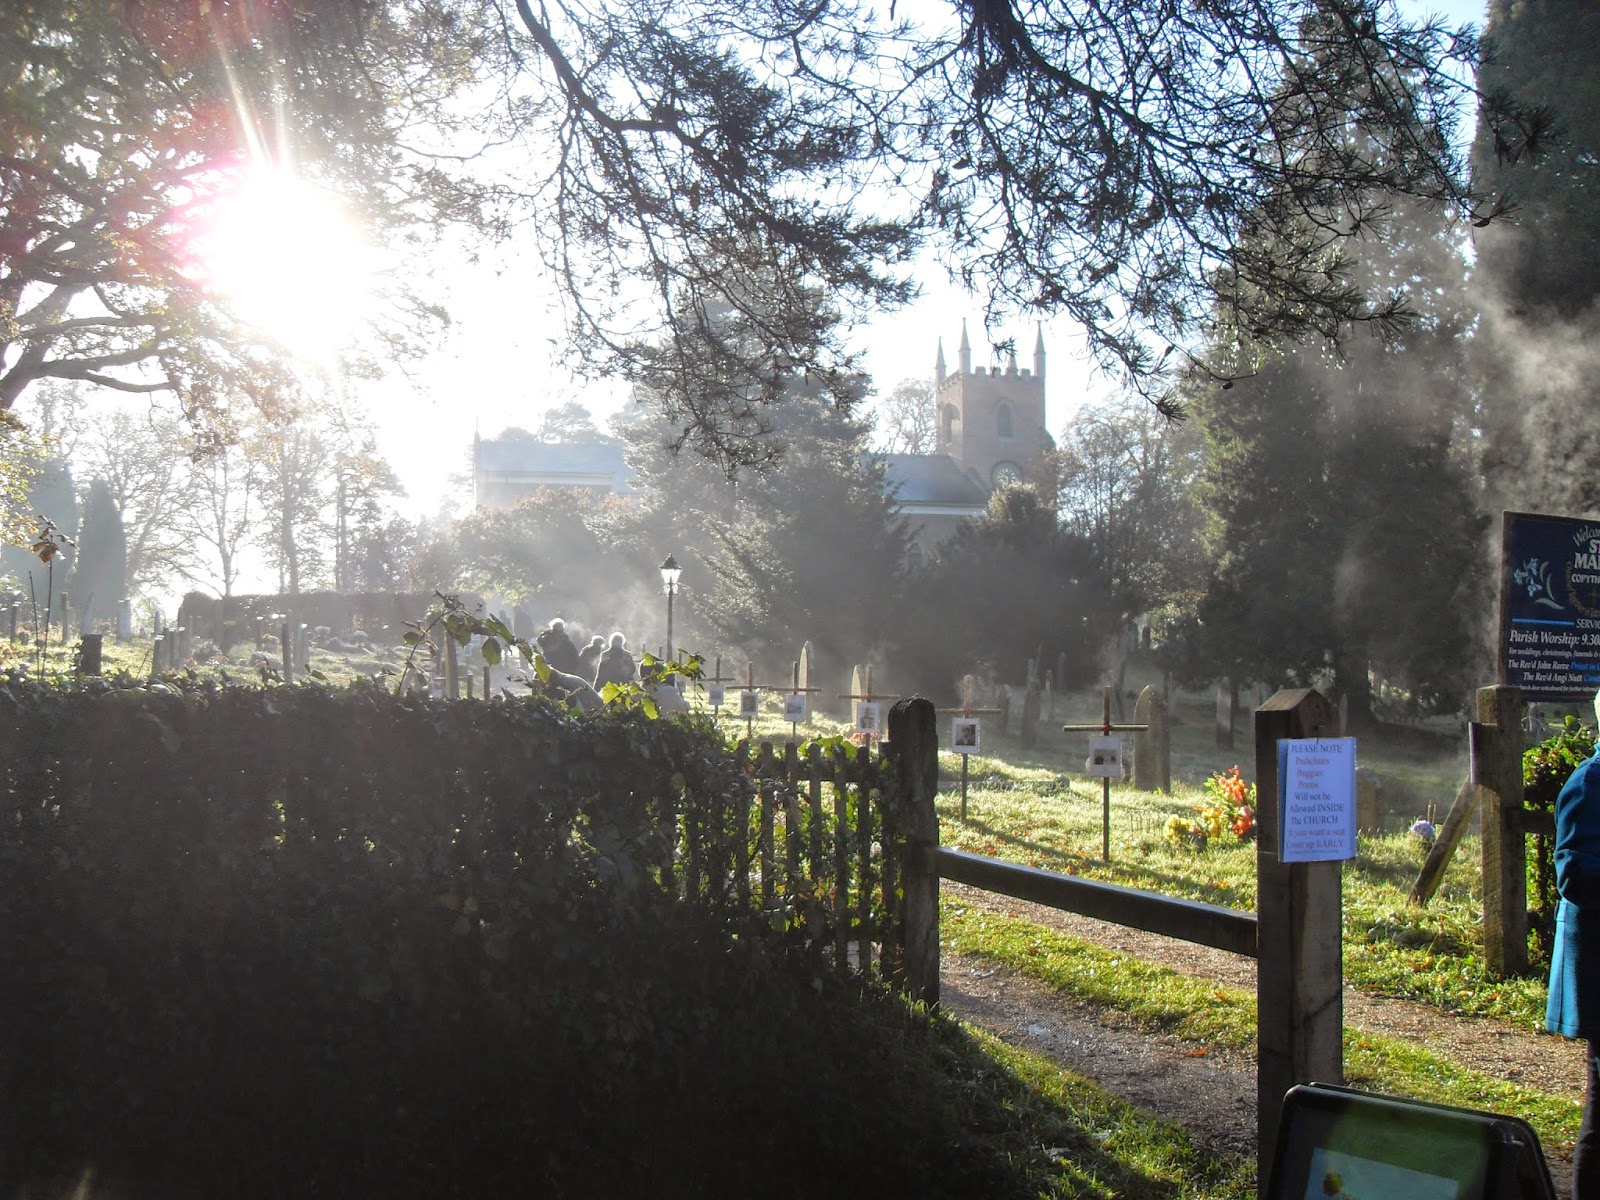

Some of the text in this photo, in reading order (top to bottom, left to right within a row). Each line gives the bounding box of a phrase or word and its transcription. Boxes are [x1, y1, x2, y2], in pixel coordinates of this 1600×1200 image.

[1509, 629, 1538, 643] Parish
[1540, 631, 1580, 648] Worship:
[1508, 659, 1519, 668] The
[1520, 659, 1537, 669] Rev'd
[1537, 661, 1552, 670] John
[1523, 672, 1535, 681] The
[1535, 673, 1552, 682] Rev'd
[1291, 744, 1343, 753] PLEASE NOTE
[1295, 756, 1330, 766] Pushchairs
[1298, 781, 1318, 789] Prams
[1294, 792, 1309, 801] Will
[1322, 792, 1331, 800] be
[1290, 803, 1345, 813] Allowed INSIDE
[1290, 815, 1338, 825] The CHURCH
[1316, 839, 1344, 848] EARLY
